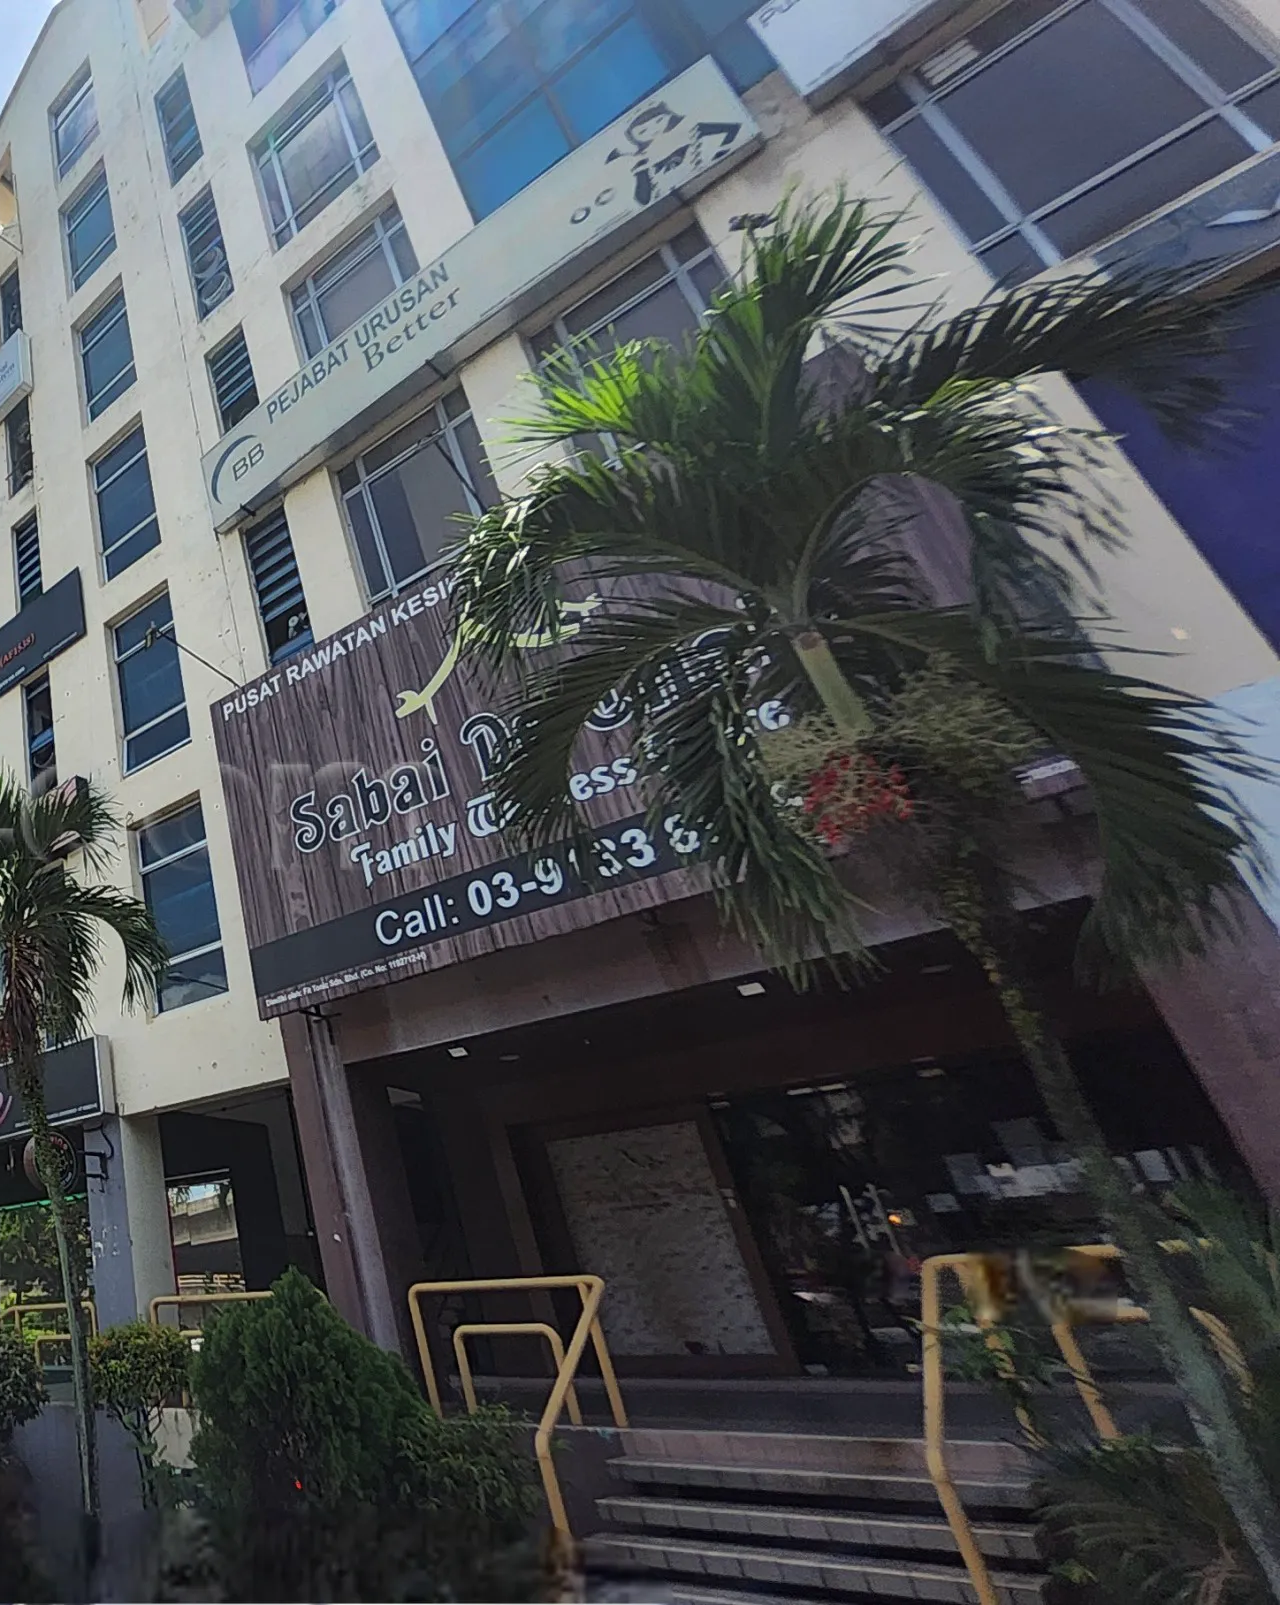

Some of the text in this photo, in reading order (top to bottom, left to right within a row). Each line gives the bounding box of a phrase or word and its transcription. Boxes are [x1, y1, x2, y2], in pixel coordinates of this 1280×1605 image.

[266, 262, 449, 424] PEJABAT URUSAN
[361, 286, 461, 374] Better
[231, 443, 266, 481] BB
[222, 672, 282, 721] PUSAT
[286, 618, 387, 687] RAWATAN
[290, 738, 450, 854] Sabai
[350, 817, 457, 888] Family
[375, 893, 460, 946] Call:
